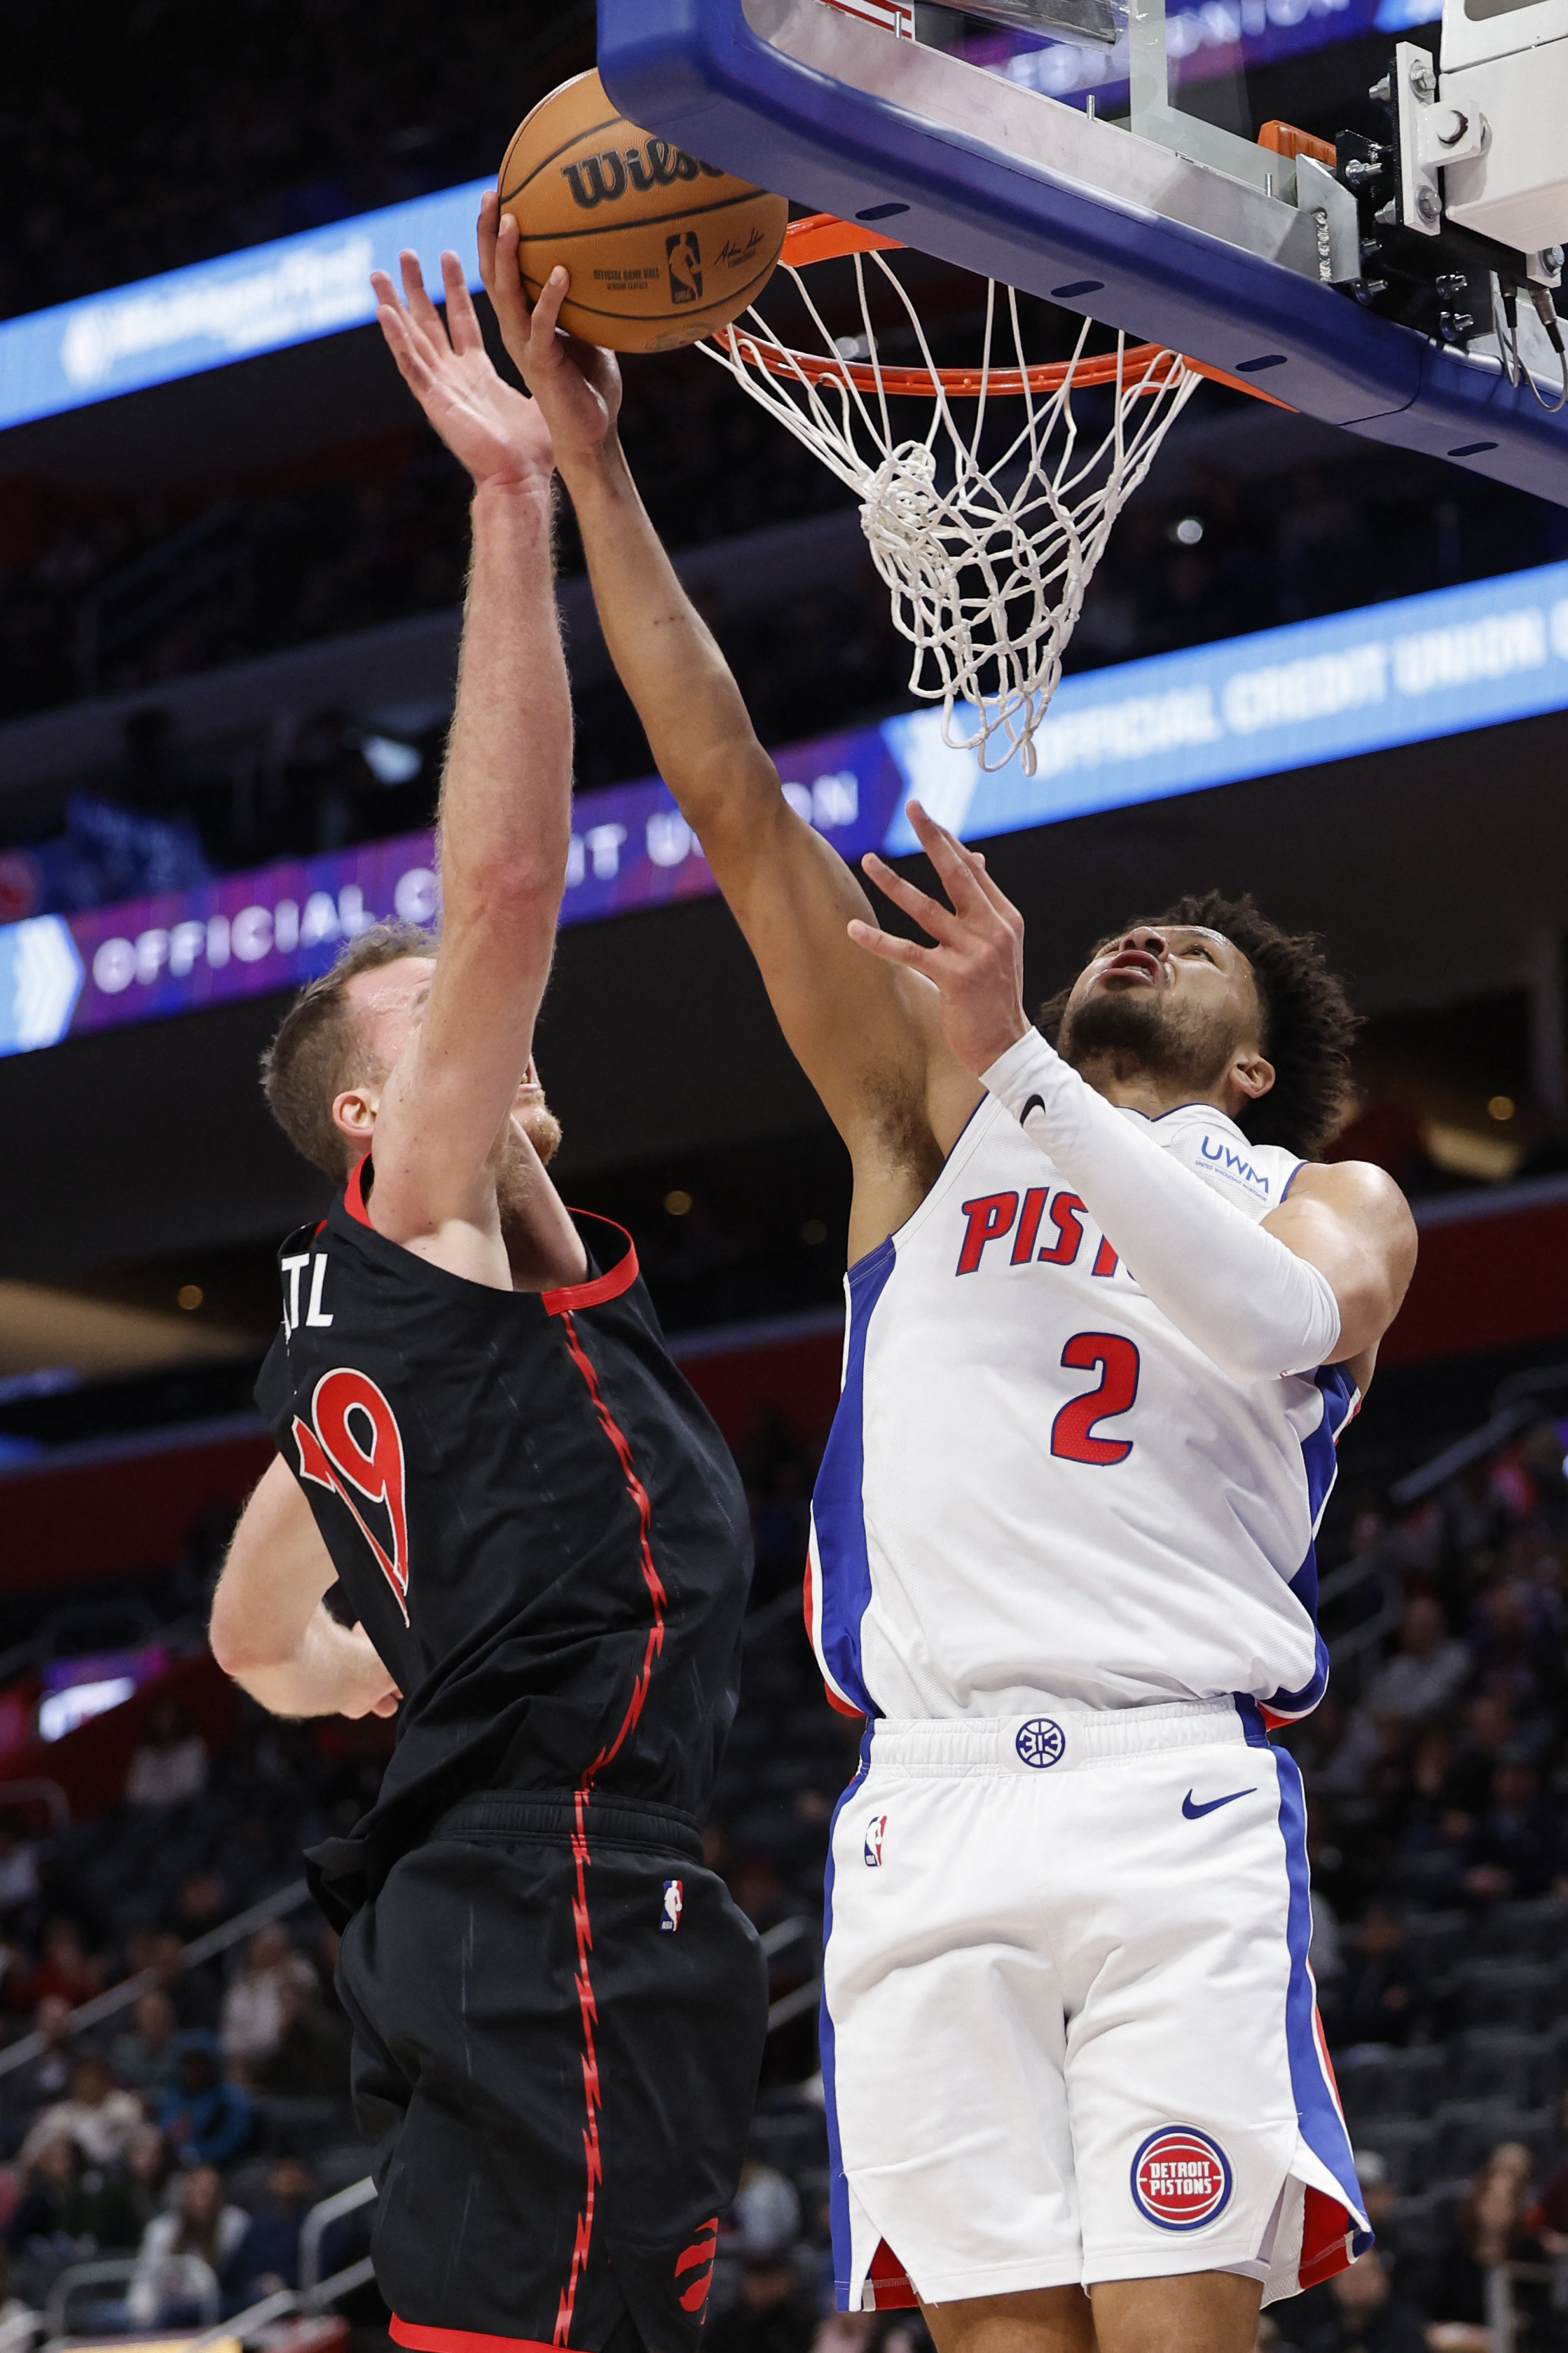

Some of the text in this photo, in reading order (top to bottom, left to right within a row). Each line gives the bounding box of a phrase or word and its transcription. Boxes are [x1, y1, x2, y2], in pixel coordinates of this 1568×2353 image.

[93, 884, 376, 994] OFFICIAL
[1201, 1135, 1269, 1195] UWM
[281, 1252, 334, 1345] TL
[1050, 1331, 1141, 1466] 2
[291, 1367, 410, 1628] 19
[1149, 2161, 1211, 2179] DETROIT
[1149, 2178, 1212, 2196] PISTONS
